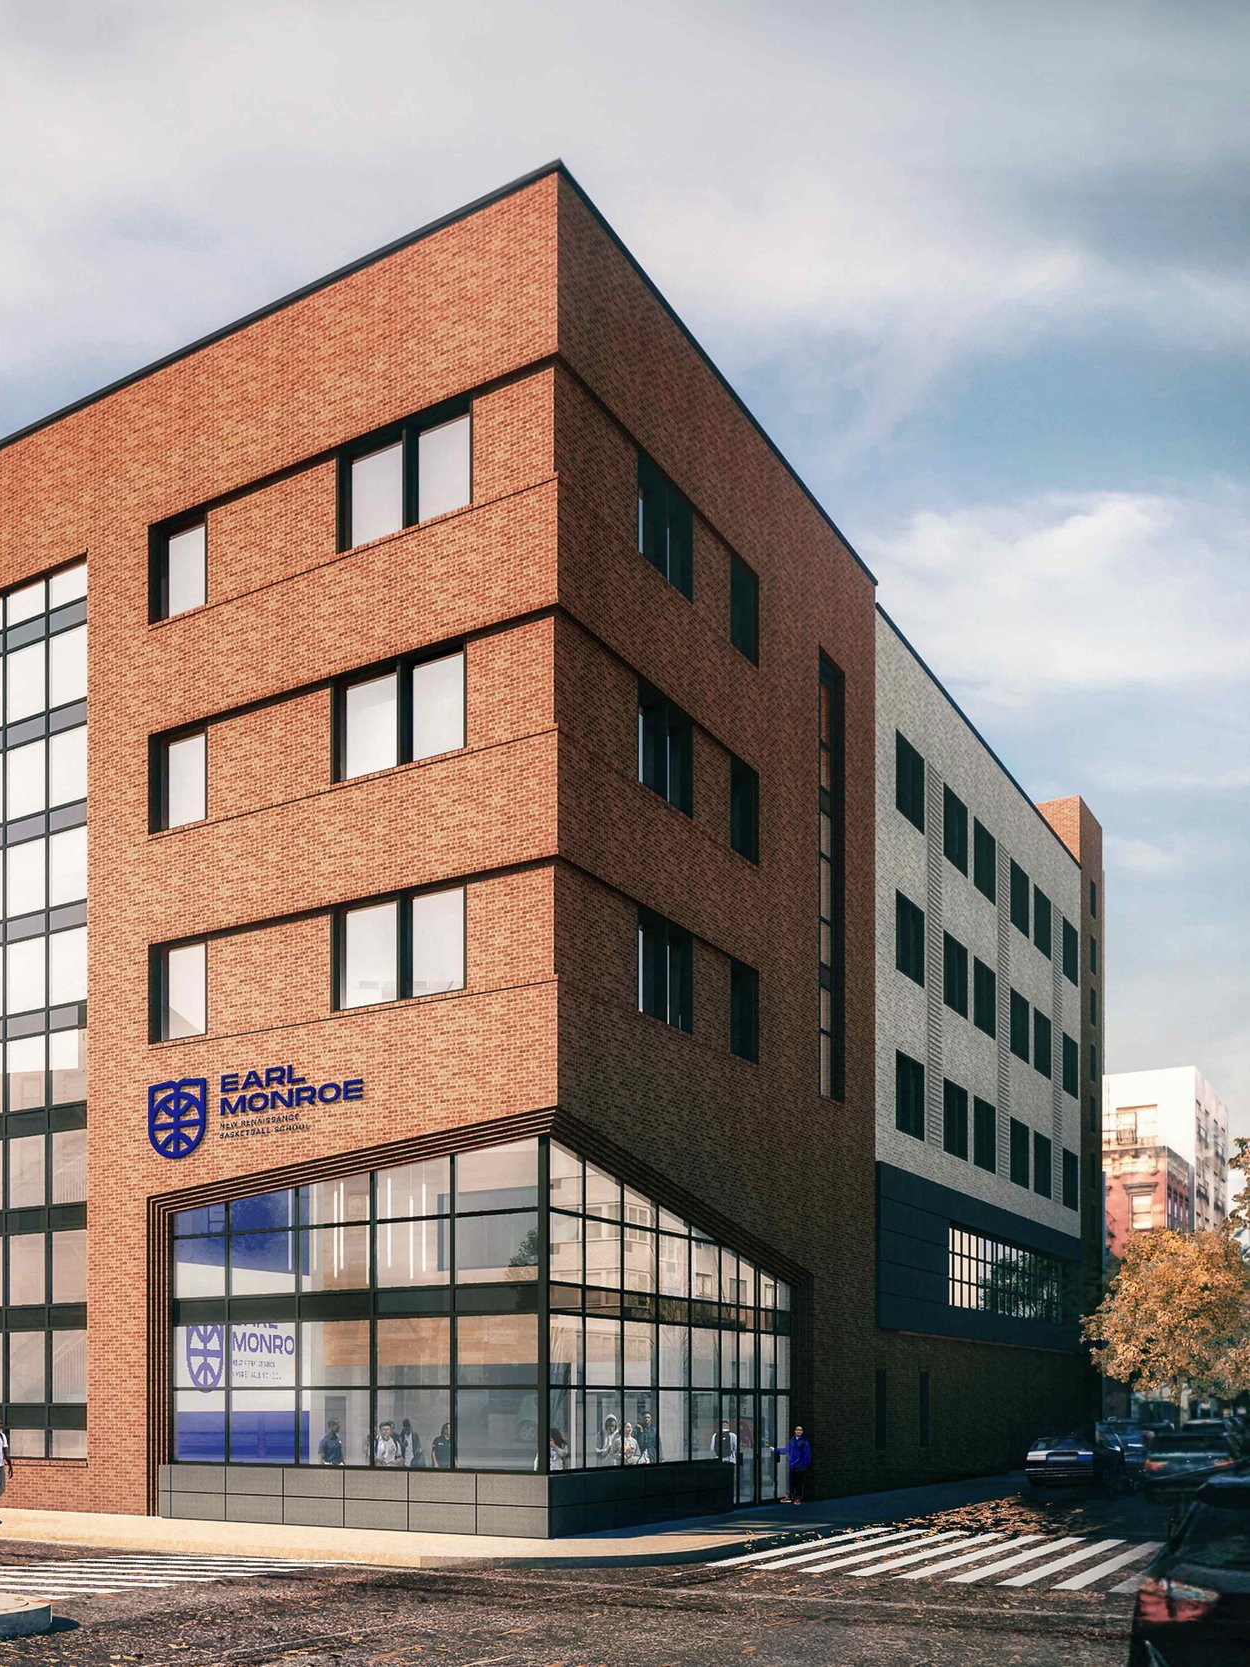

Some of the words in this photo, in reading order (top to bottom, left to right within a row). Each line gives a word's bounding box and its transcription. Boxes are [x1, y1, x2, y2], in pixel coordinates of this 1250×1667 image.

[220, 1064, 305, 1093] EARL
[220, 1077, 364, 1116] MONROE
[219, 1128, 271, 1139] BASKETBALL
[274, 1123, 311, 1133] SCHOOL
[220, 1121, 238, 1130] NEW
